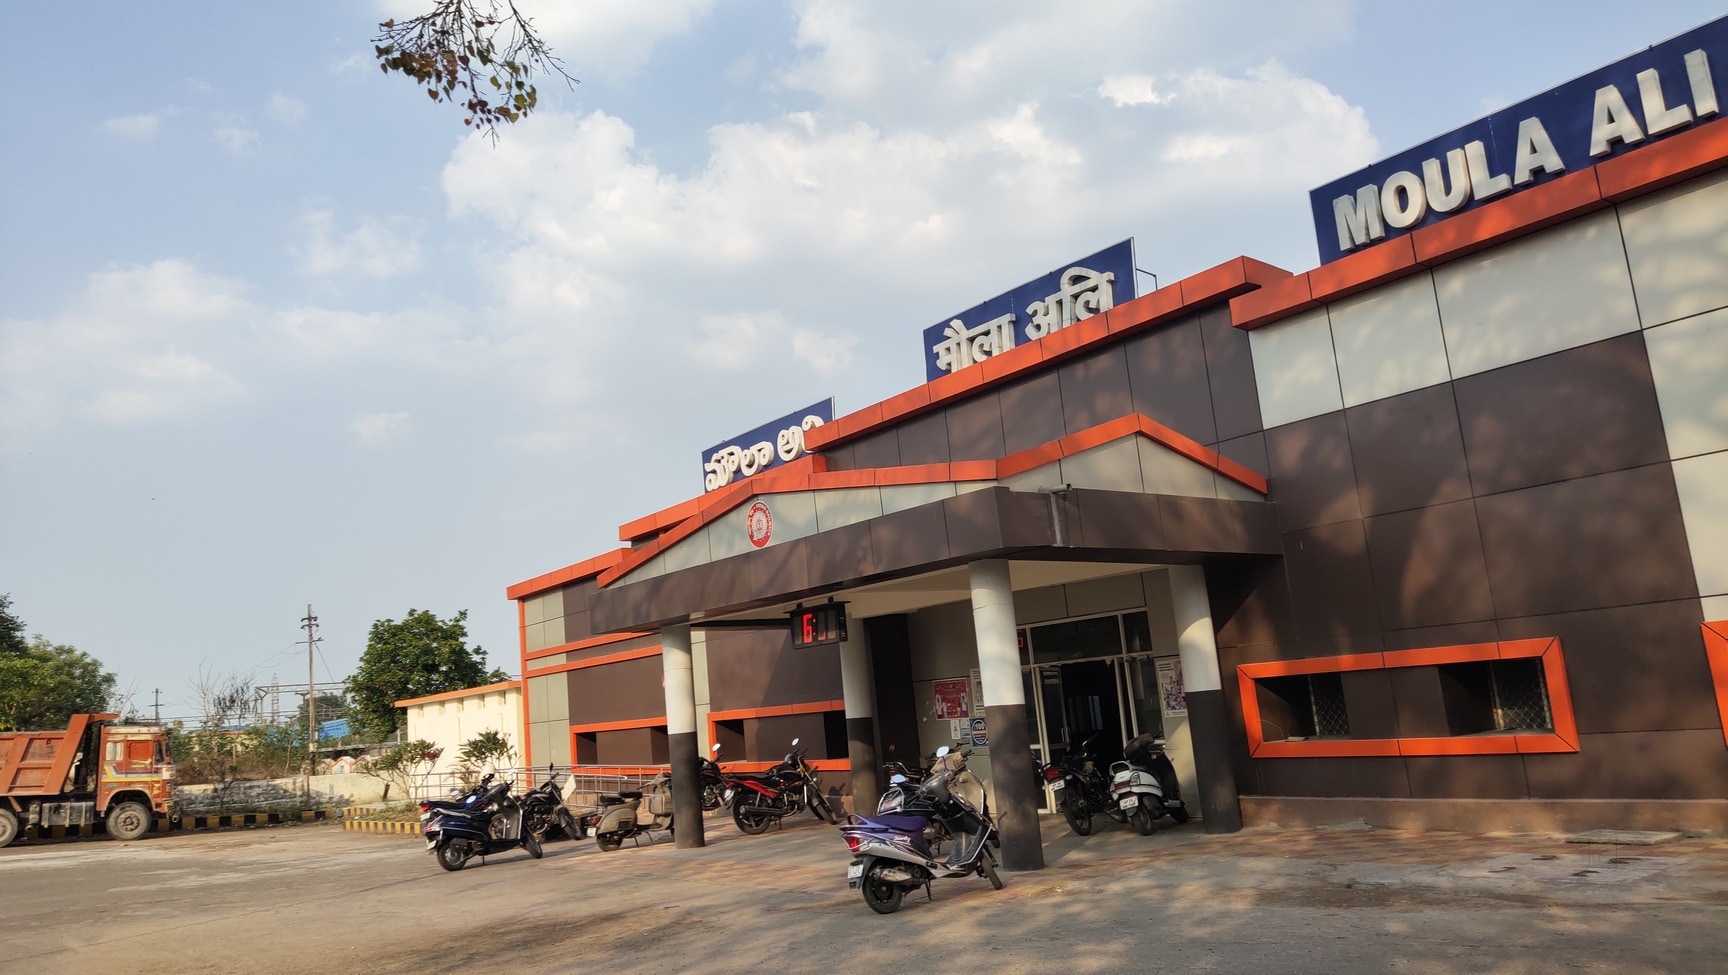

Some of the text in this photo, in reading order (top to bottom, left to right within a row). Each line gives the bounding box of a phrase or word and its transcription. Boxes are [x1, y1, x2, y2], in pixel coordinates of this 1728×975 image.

[1332, 48, 1719, 252] MOULA ALI
[933, 266, 1115, 373] मौला अलि
